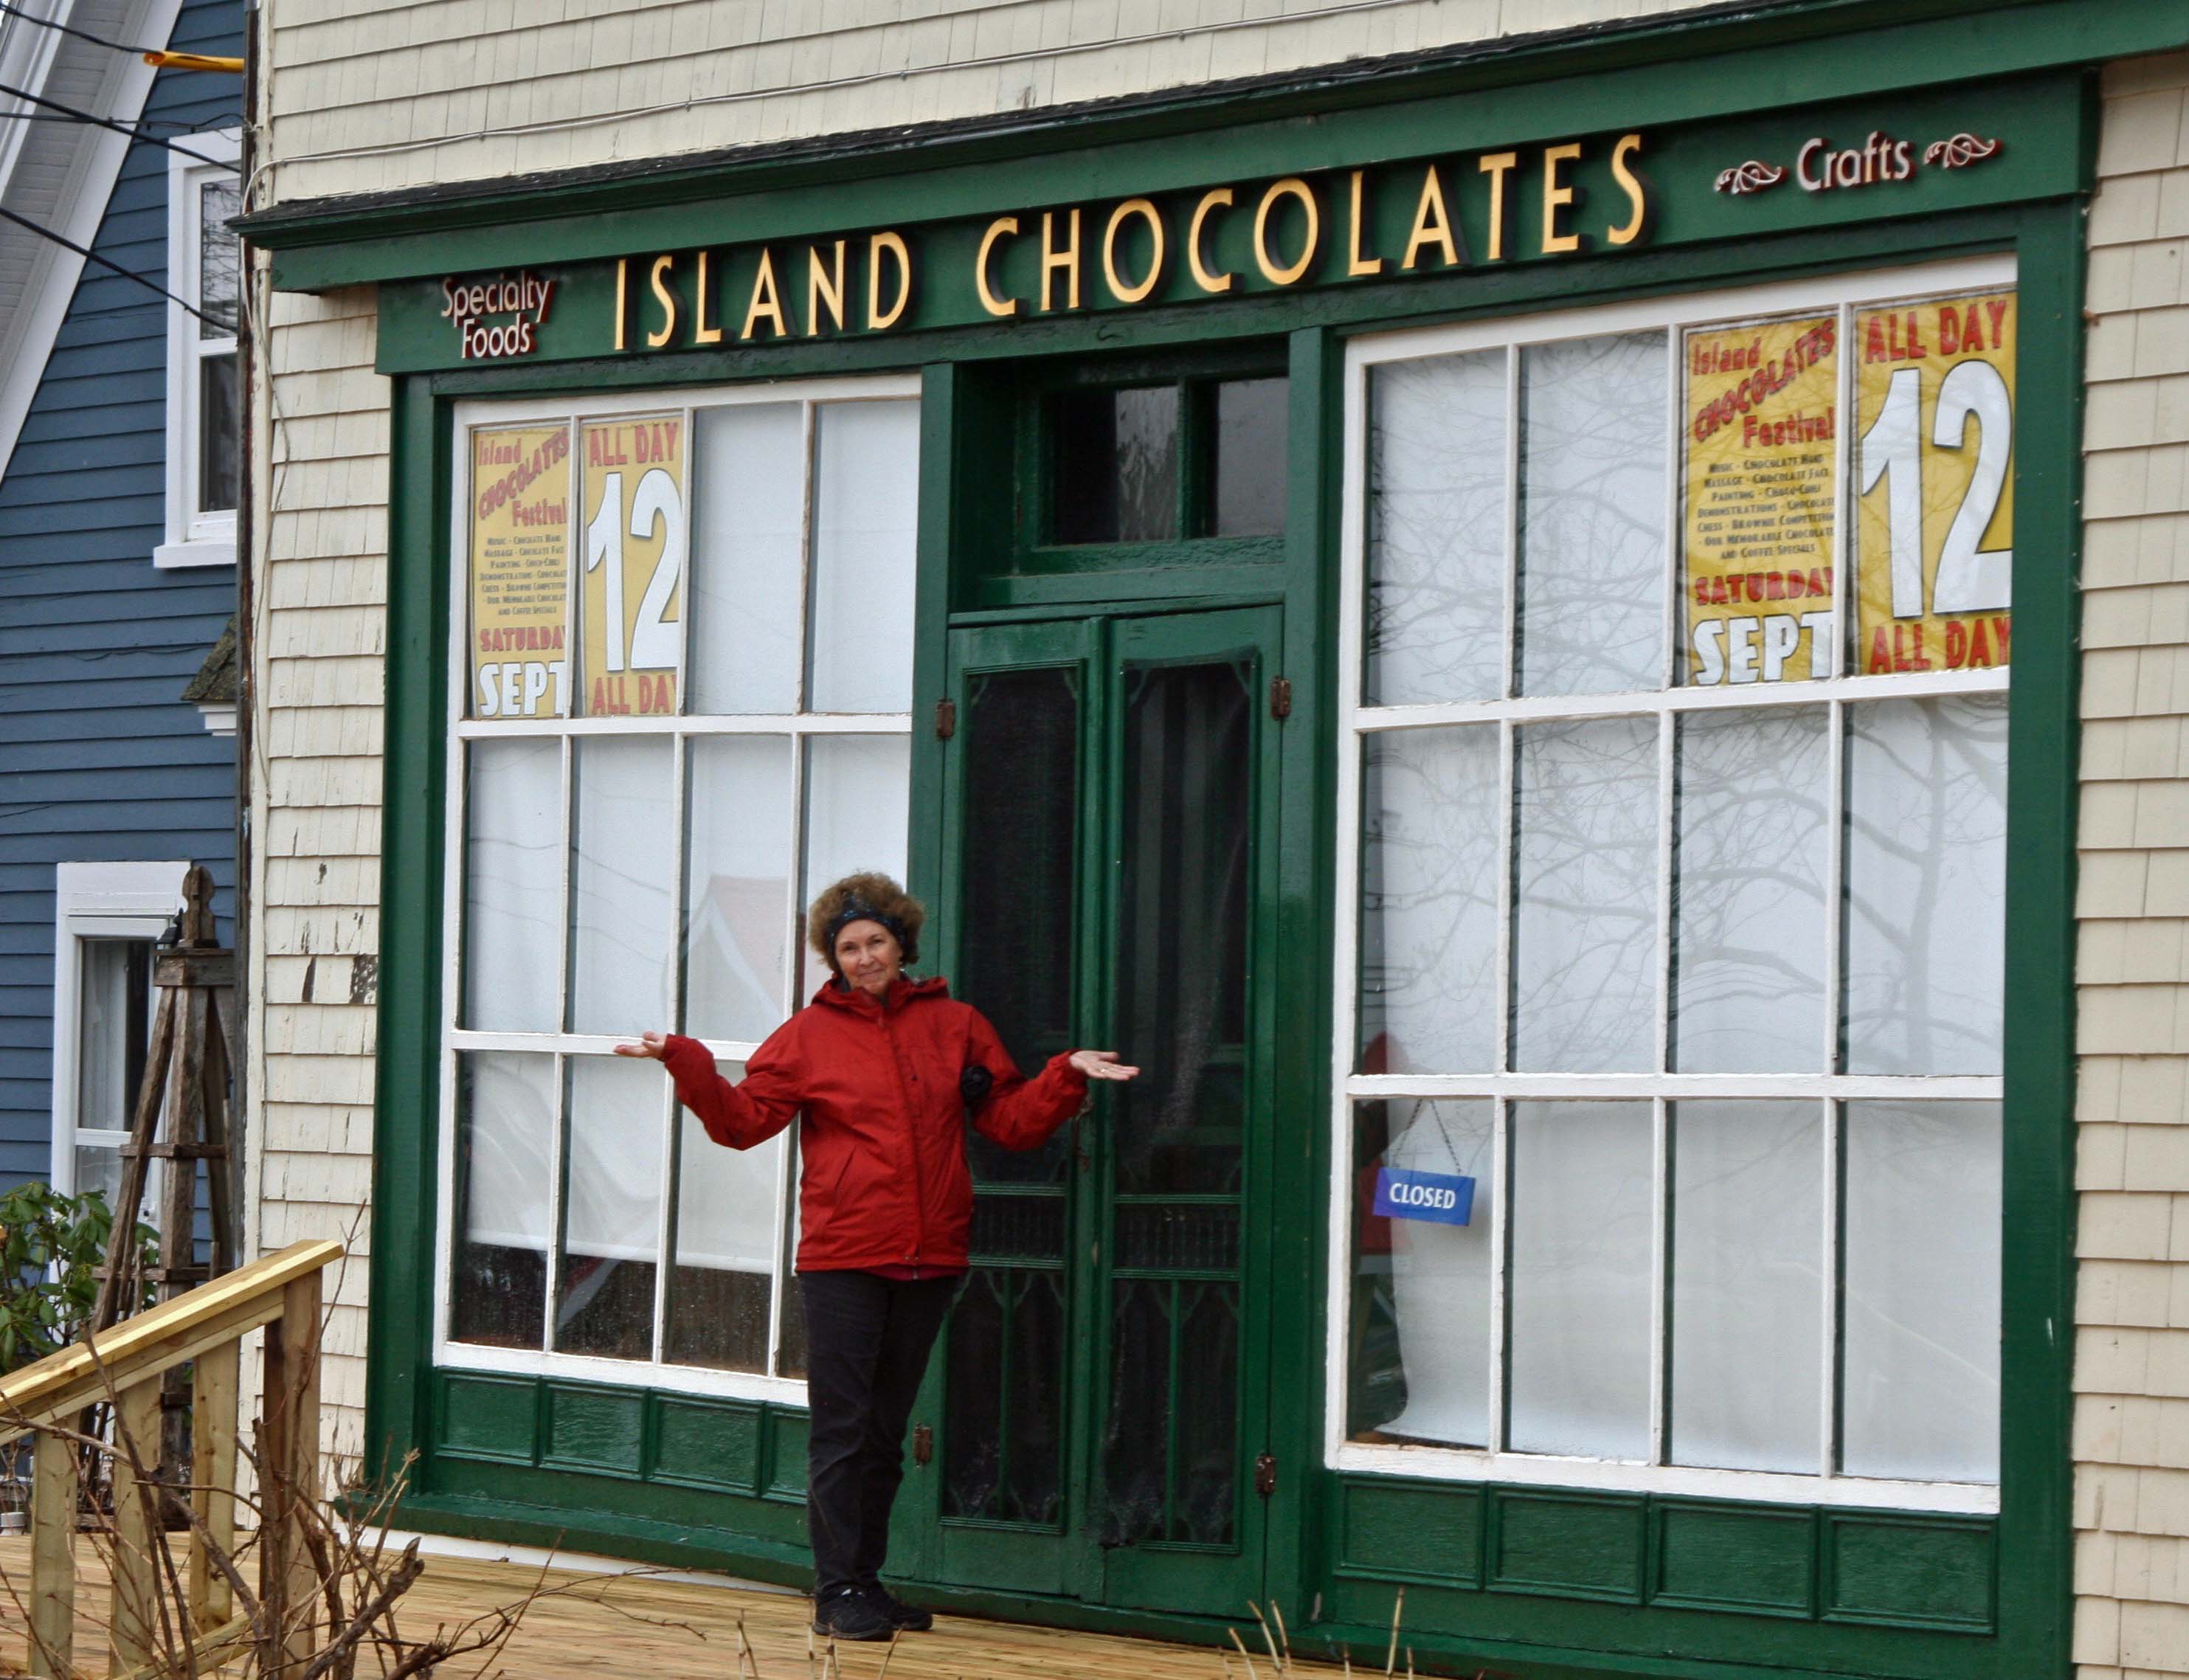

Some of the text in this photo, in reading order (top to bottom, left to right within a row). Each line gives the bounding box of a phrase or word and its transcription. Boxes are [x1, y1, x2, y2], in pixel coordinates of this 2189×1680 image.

[1796, 130, 1914, 192] Crafts
[614, 134, 1646, 351] ISLAND CHOCOLATES
[440, 270, 552, 328] Specialty
[461, 312, 534, 359] Foods
[1693, 337, 1761, 376] Island
[1866, 300, 2008, 364] ALL DAY
[1695, 318, 1835, 443] CHOCOLATES
[477, 438, 521, 466] Island
[589, 422, 678, 466] ALL DAY
[1743, 406, 1835, 448] Festival
[513, 497, 567, 527] Festival
[1861, 359, 2013, 619] 12
[587, 467, 682, 672] 12
[480, 626, 566, 651] SATURDA
[1692, 610, 1833, 685] SEPT
[1870, 617, 2010, 674] ALL DAY
[479, 660, 567, 716] SEPT
[592, 677, 631, 715] ALL
[1389, 1182, 1456, 1209] CLOSED
